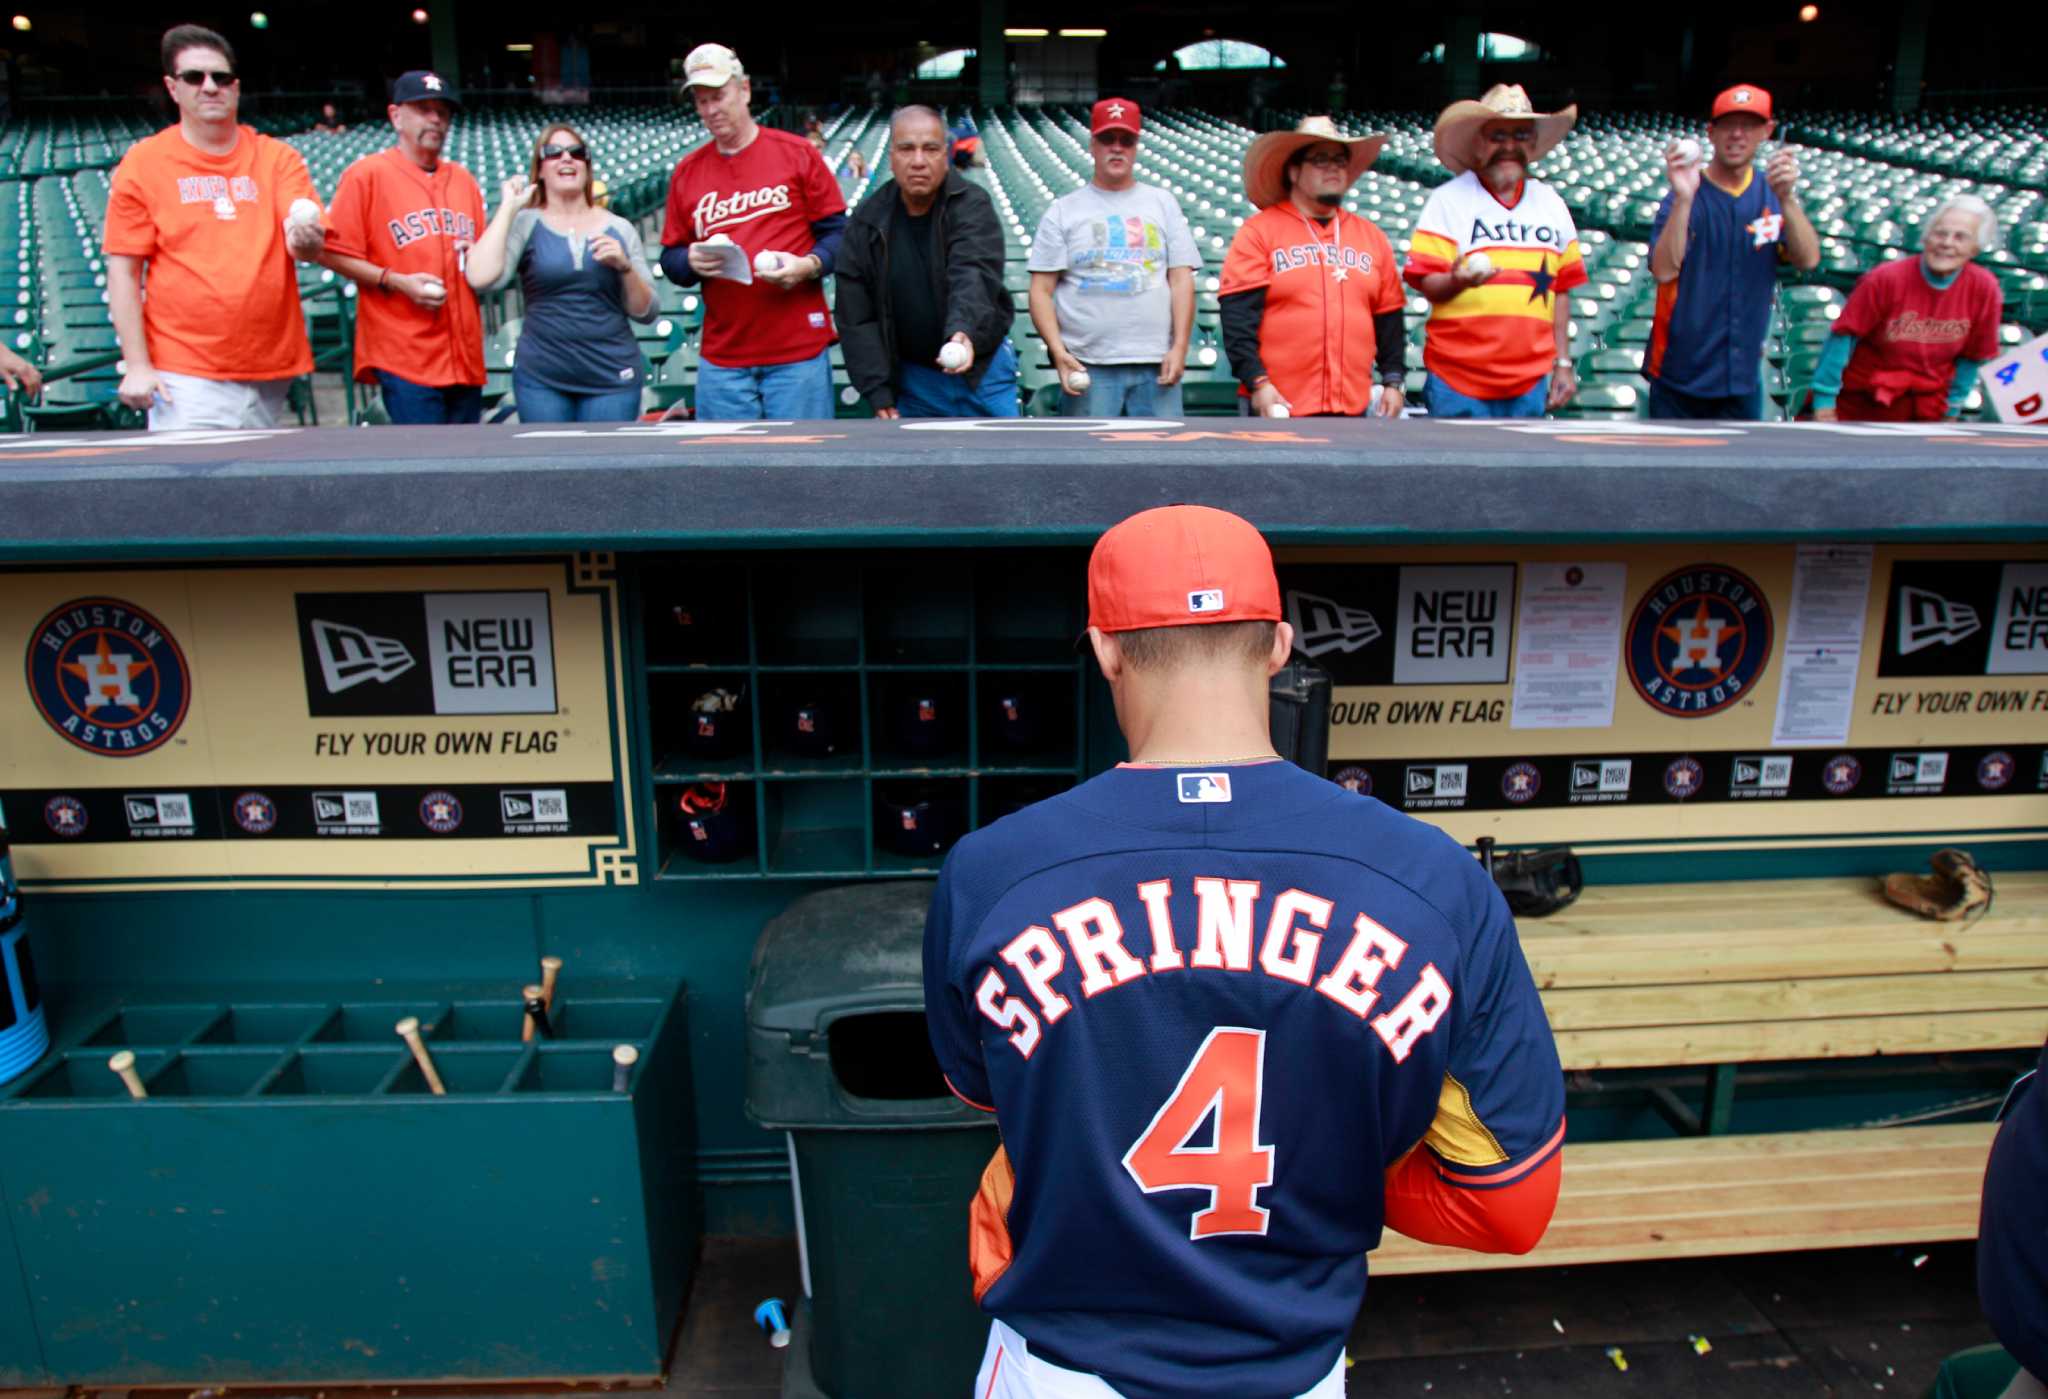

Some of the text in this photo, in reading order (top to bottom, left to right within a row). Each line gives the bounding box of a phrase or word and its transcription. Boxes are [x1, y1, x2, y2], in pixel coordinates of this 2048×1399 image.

[692, 184, 792, 240] Astros
[1273, 243, 1372, 275] ASTROS
[1413, 590, 1498, 624] NEW
[1649, 573, 1758, 615] HOUSTON
[41, 607, 163, 651] HOUSTON
[443, 618, 534, 652] NEW
[1411, 626, 1494, 658] ERA
[447, 655, 537, 688] ERA
[1646, 675, 1742, 709] ASTROS
[1872, 692, 1911, 714] FLY
[1916, 691, 1972, 714] YOUR
[1975, 690, 2029, 713] OWN
[1329, 699, 1505, 725] OUR OWN FLAG
[62, 712, 168, 748] ASTROS
[315, 730, 559, 756] FLY YOUR OWN FLAG
[977, 876, 1453, 1064] SPRINGER
[1122, 1026, 1275, 1241] 4
